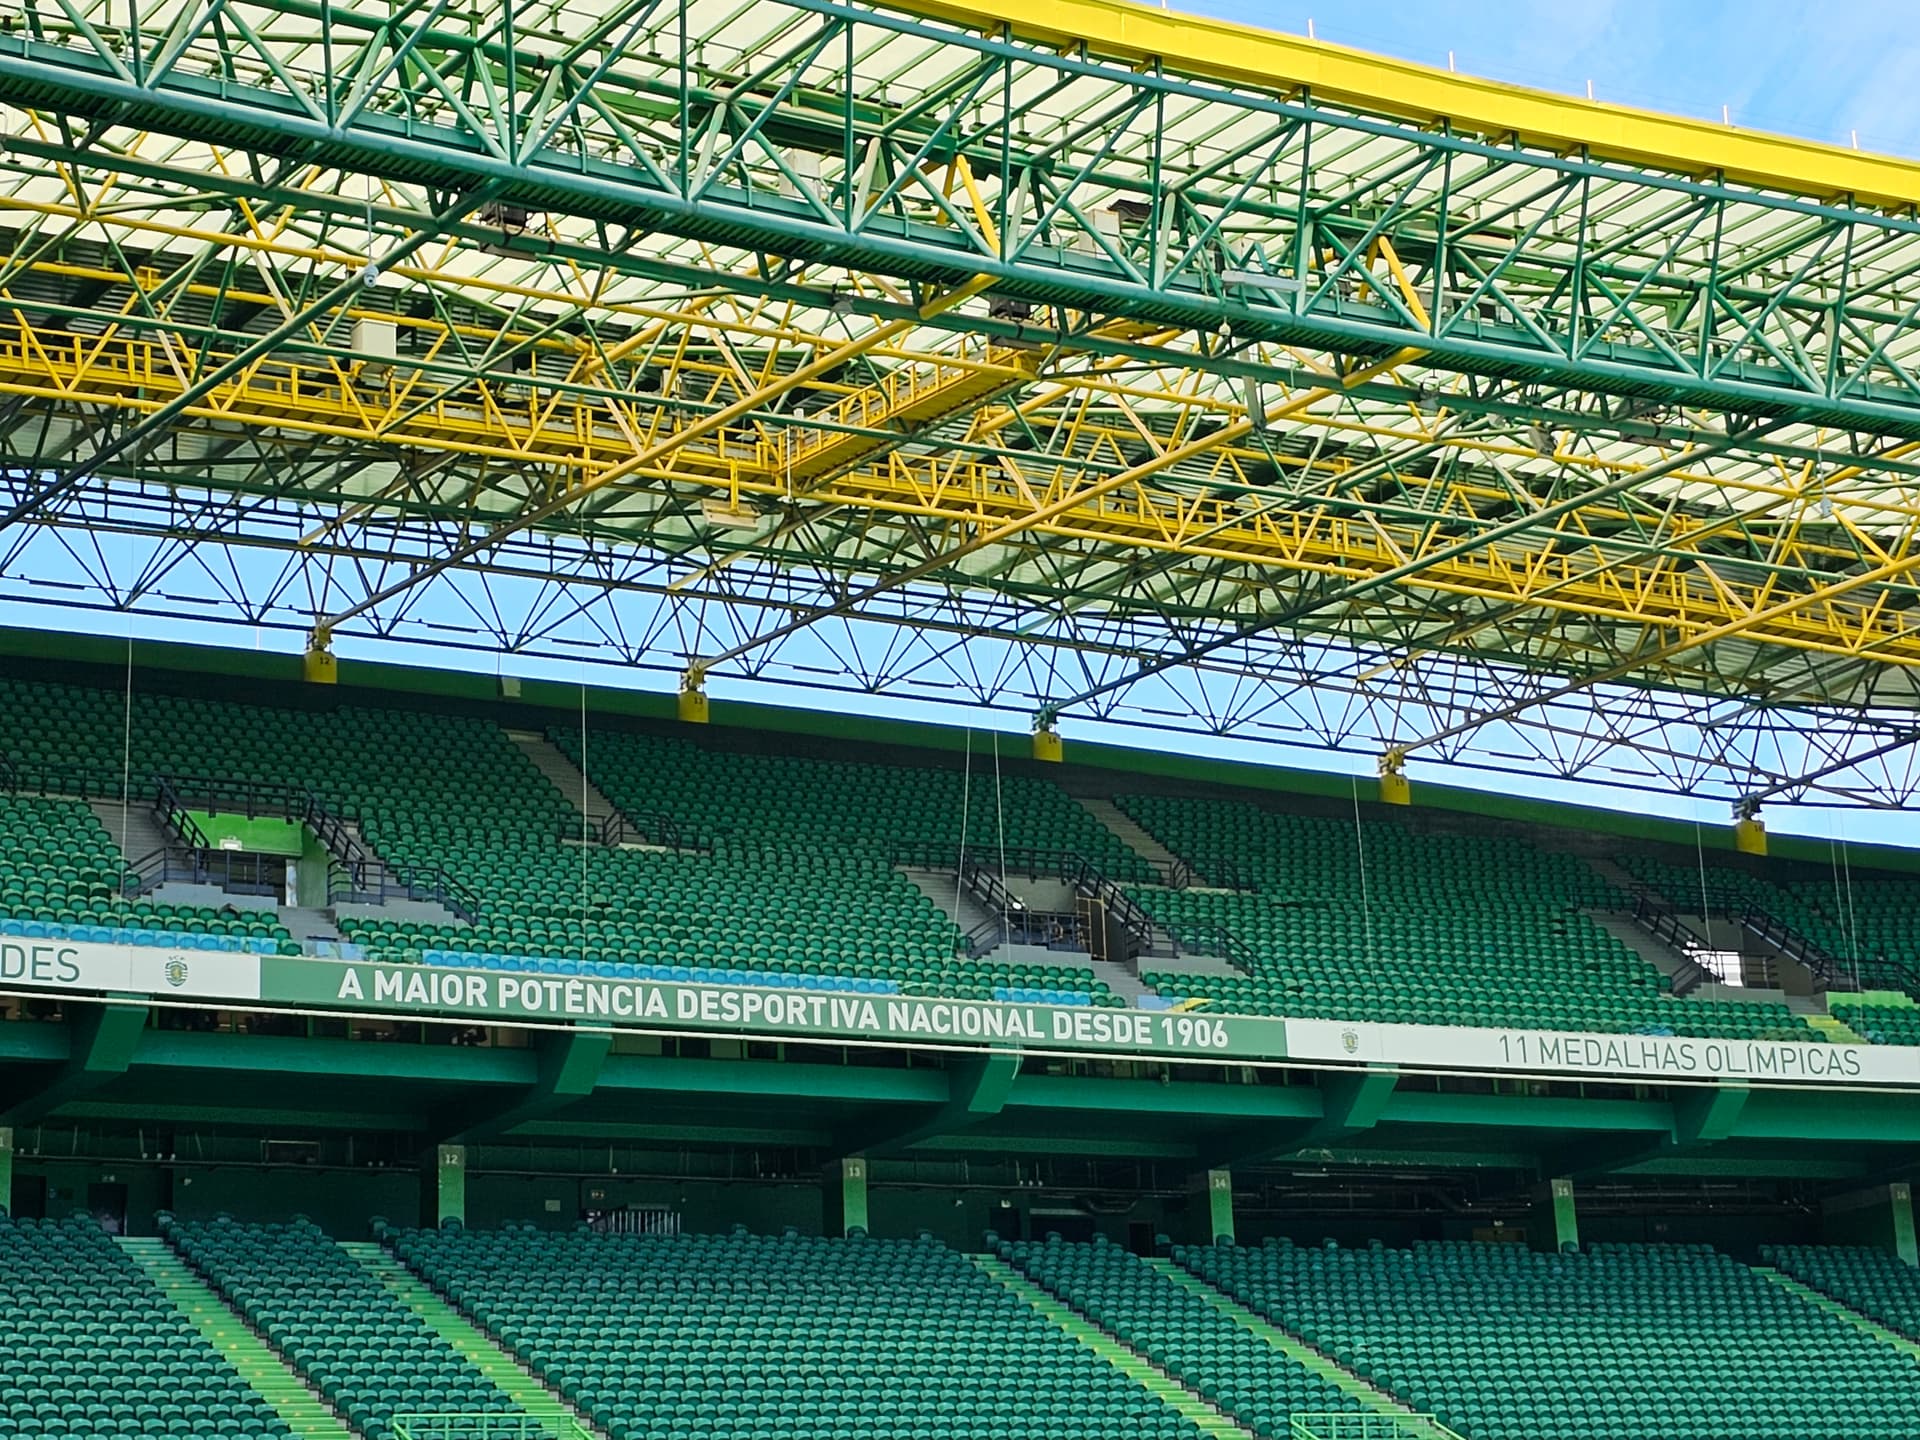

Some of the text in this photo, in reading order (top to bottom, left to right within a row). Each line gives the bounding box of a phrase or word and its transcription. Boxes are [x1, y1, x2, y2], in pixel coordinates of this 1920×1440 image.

[320, 656, 330, 665] 12
[1, 943, 80, 983] DES
[337, 967, 1229, 1049] A MAIOR POTÊNCIA DESPORTIVA NACIONAL DESDE 1906
[1499, 1034, 1862, 1076] 11 MEDALHAS OLÍMPICAS
[445, 1153, 459, 1165] 12
